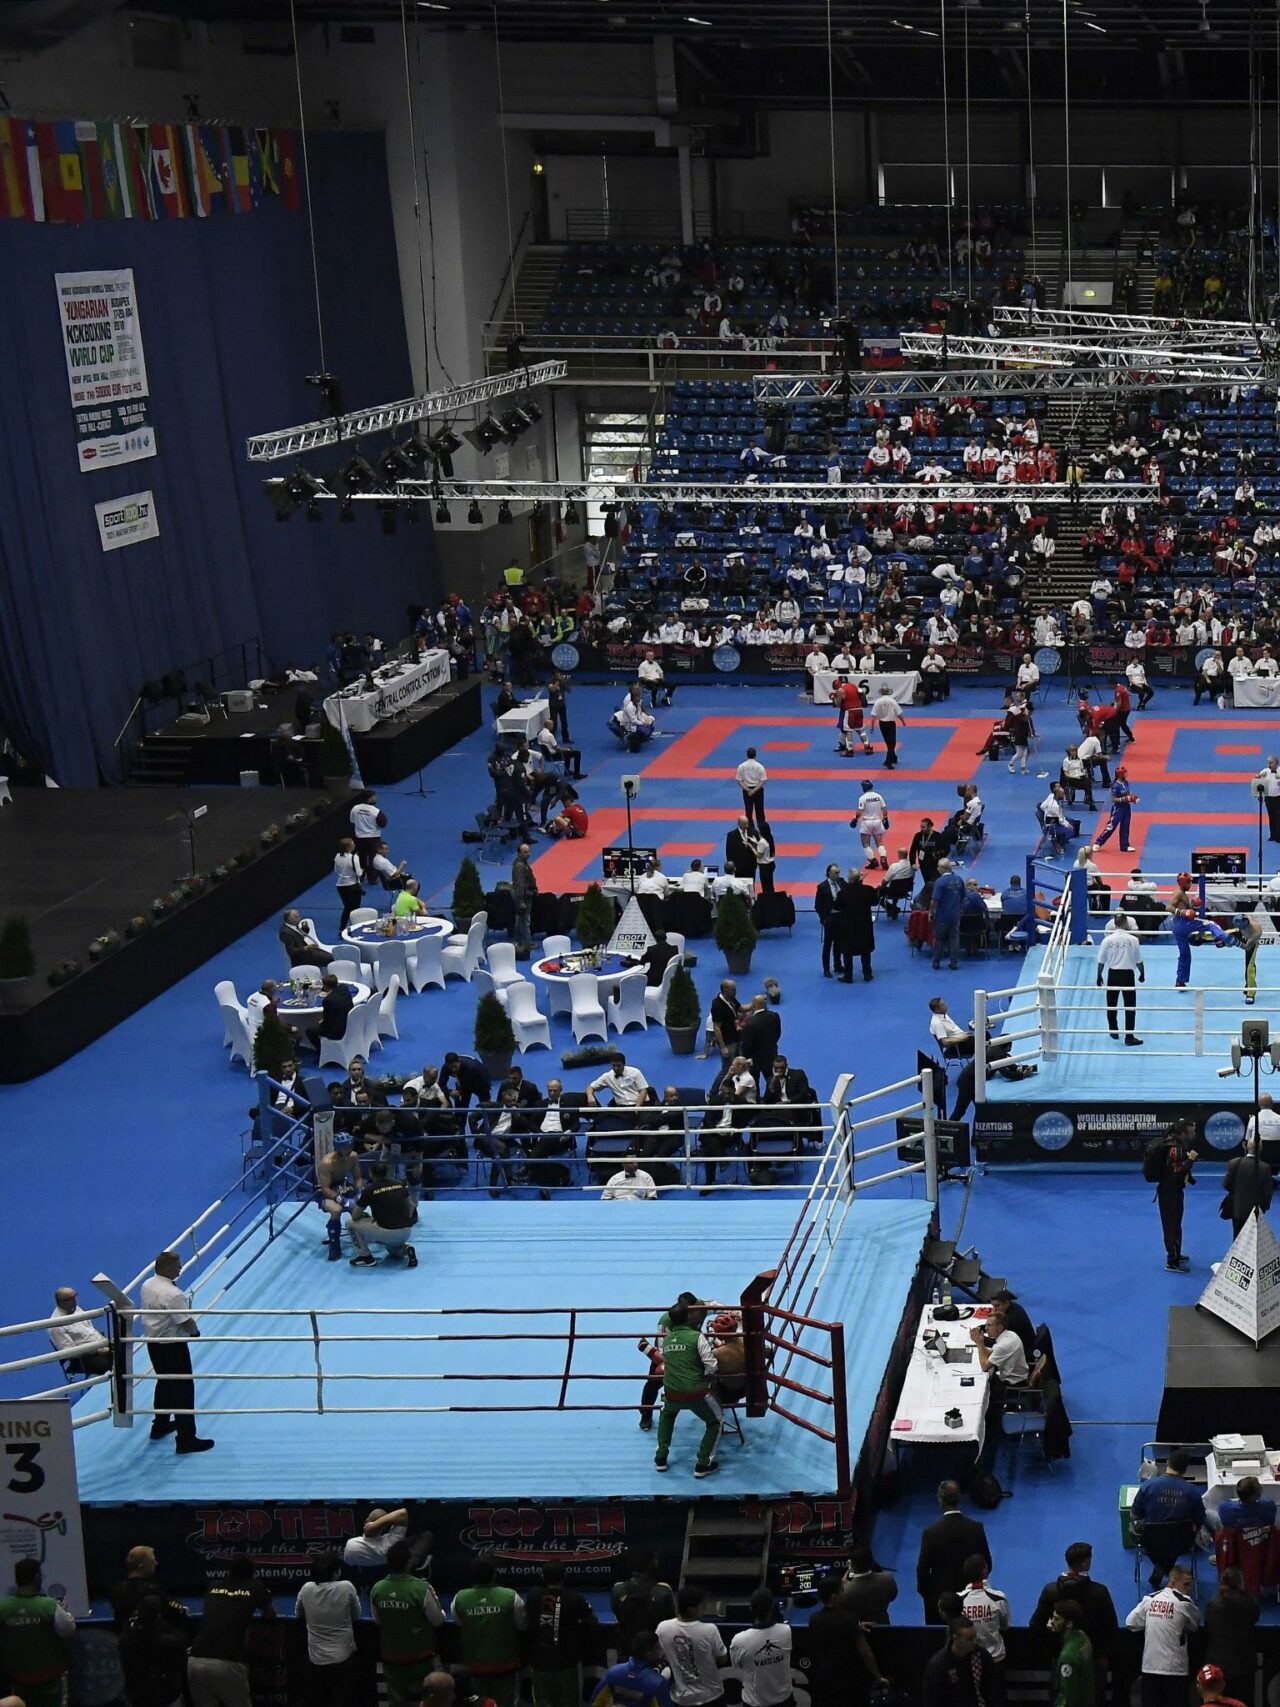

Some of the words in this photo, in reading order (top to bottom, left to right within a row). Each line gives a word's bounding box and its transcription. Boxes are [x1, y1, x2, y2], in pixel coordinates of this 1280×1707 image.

[99, 344, 114, 363] CUP
[858, 680, 870, 695] 6
[1077, 1114, 1104, 1122] WORLD
[1106, 1114, 1157, 1122] ASSOCIATION
[1077, 1122, 1086, 1131] OF
[1087, 1122, 1135, 1131] KICKBOXING
[1229, 1257, 1255, 1279] sport
[1259, 1257, 1280, 1280] sport
[1225, 1268, 1240, 1285] 100
[1238, 1276, 1250, 1291] hu
[6, 1443, 46, 1494] 3
[196, 1510, 273, 1541] TOP
[273, 1508, 356, 1540] TEN
[469, 1508, 545, 1536] TOP
[545, 1507, 626, 1536] TEN
[271, 1543, 298, 1554] the
[543, 1540, 567, 1550] the
[466, 1605, 501, 1617] MEXICO
[1149, 1600, 1175, 1615] SERBIA
